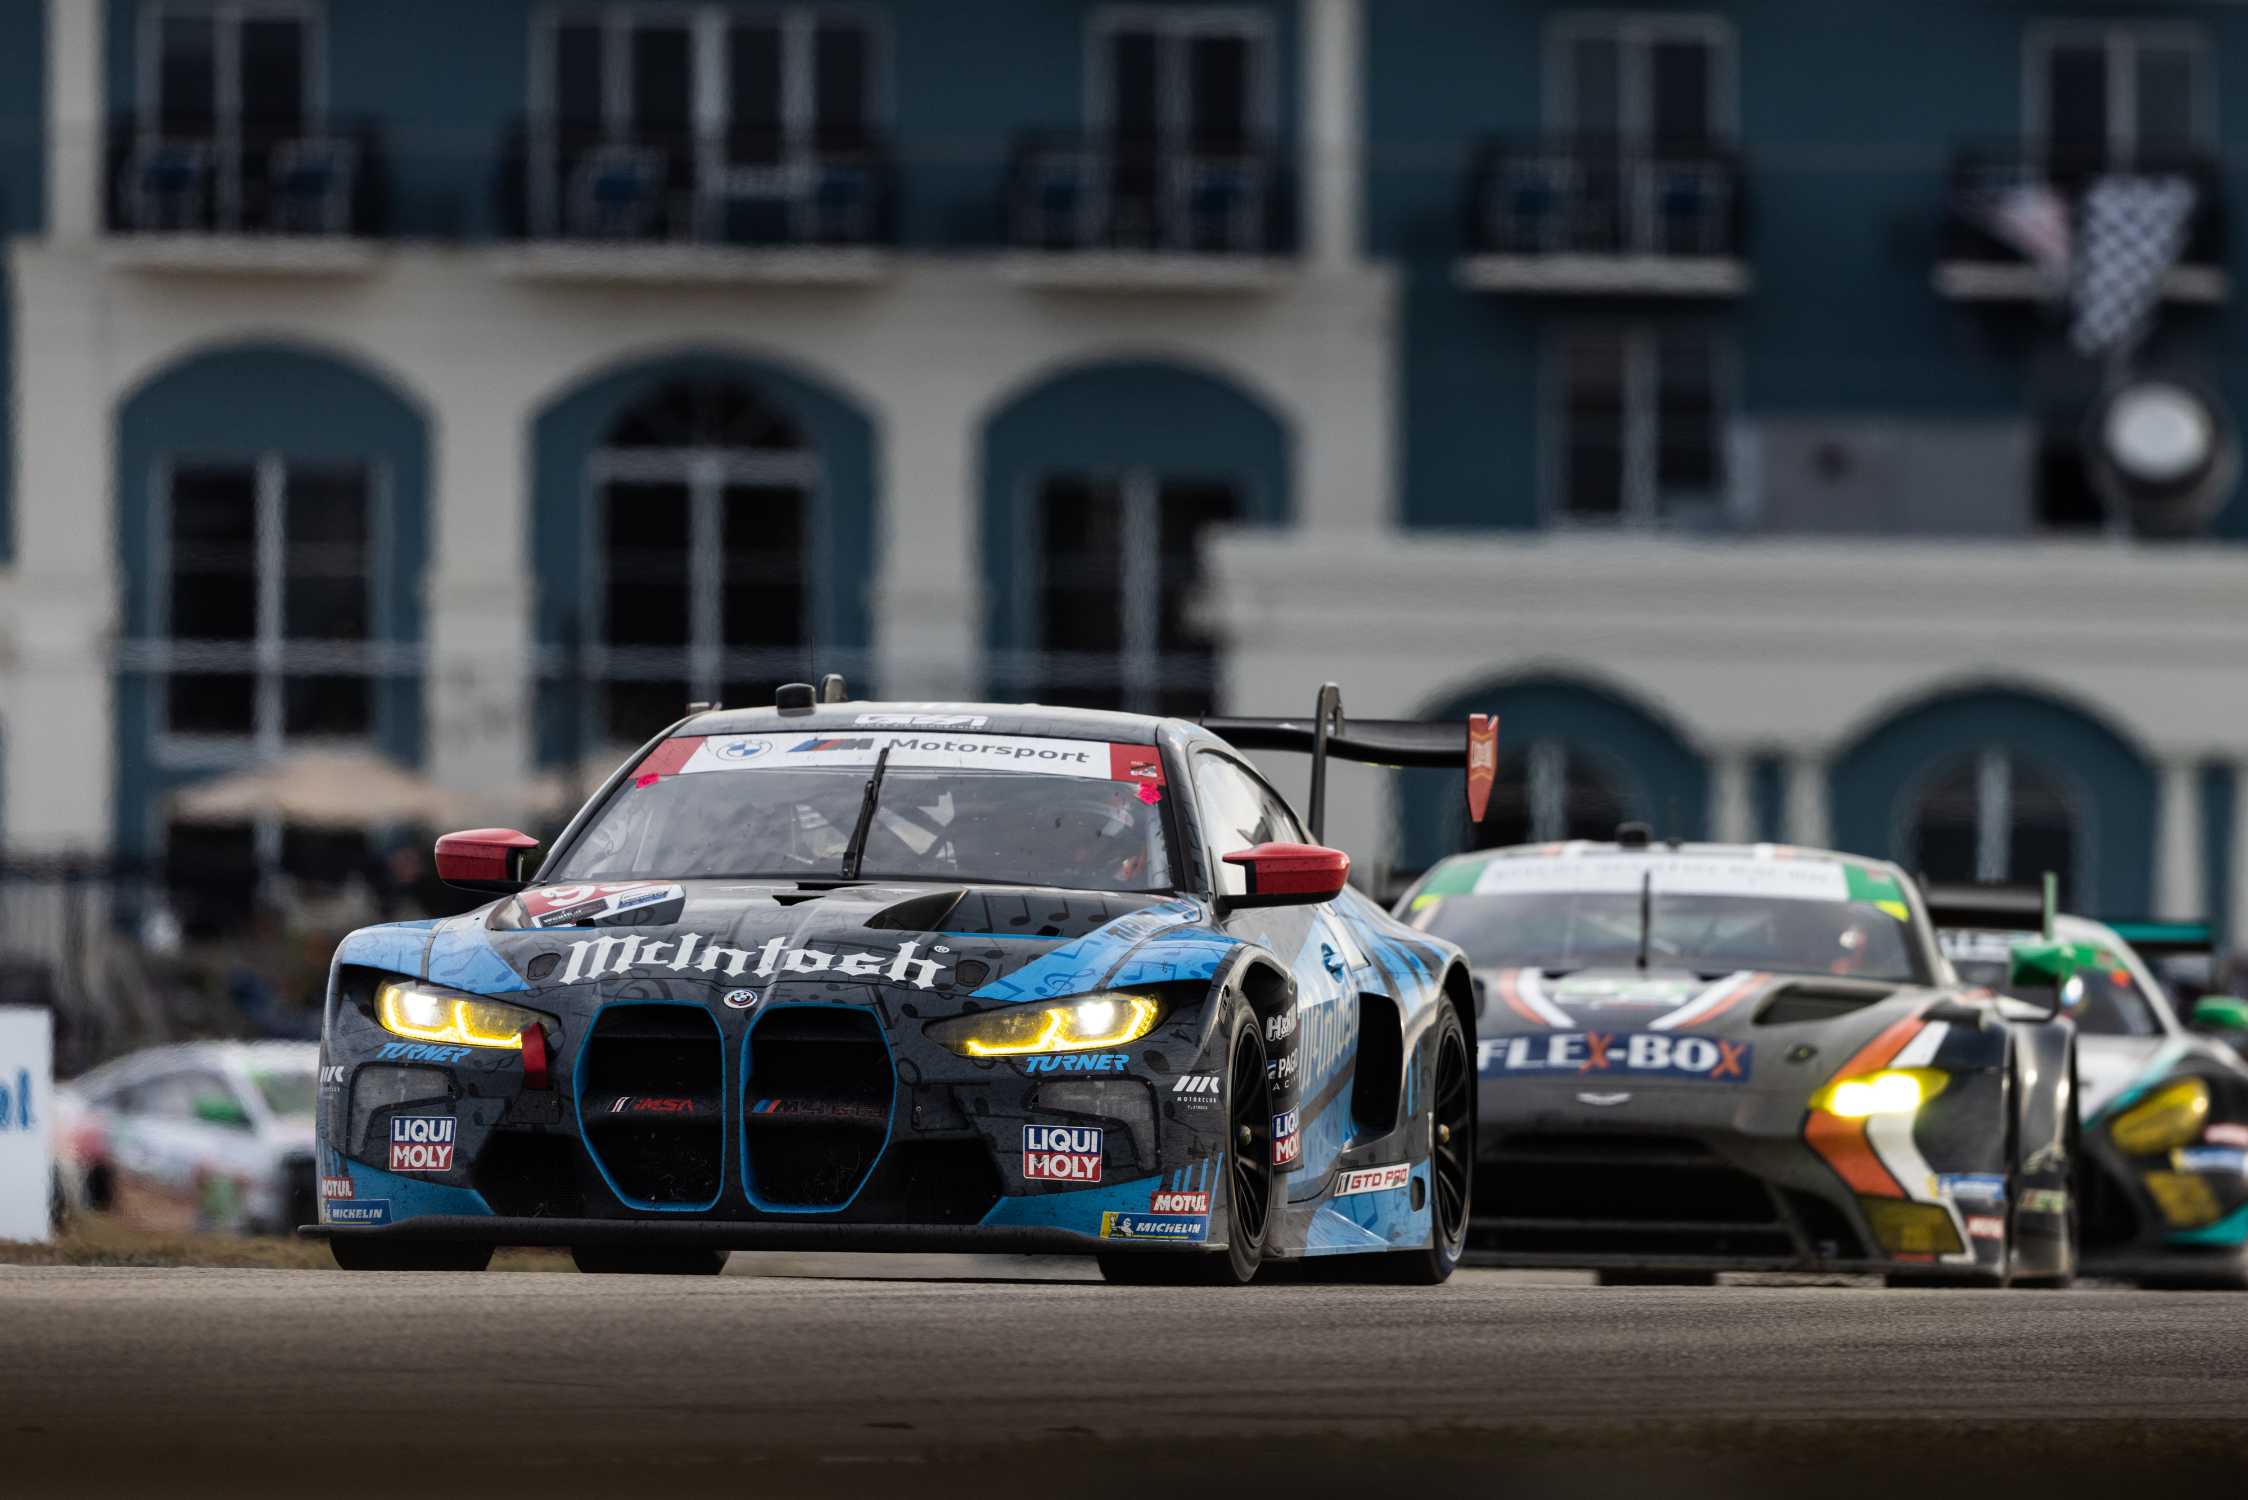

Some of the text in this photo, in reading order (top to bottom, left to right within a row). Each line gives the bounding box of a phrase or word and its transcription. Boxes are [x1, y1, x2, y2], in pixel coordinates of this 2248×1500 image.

[888, 738, 1091, 763] Motorsport
[558, 931, 948, 990] McIntosh
[376, 1042, 473, 1064] TURNER
[1026, 1054, 1130, 1073] TURNER
[1477, 1029, 1746, 1079] FLEX-BOX
[393, 1119, 453, 1143] LIQUI
[1028, 1127, 1098, 1153] LIQUI
[392, 1144, 452, 1168] MOLY
[1027, 1153, 1100, 1179] MOLY
[1350, 1167, 1408, 1190] GTD PRO
[332, 1208, 383, 1220] MICHELIN
[1153, 1194, 1207, 1212] MOTUL
[1135, 1221, 1201, 1234] MICHELIN
